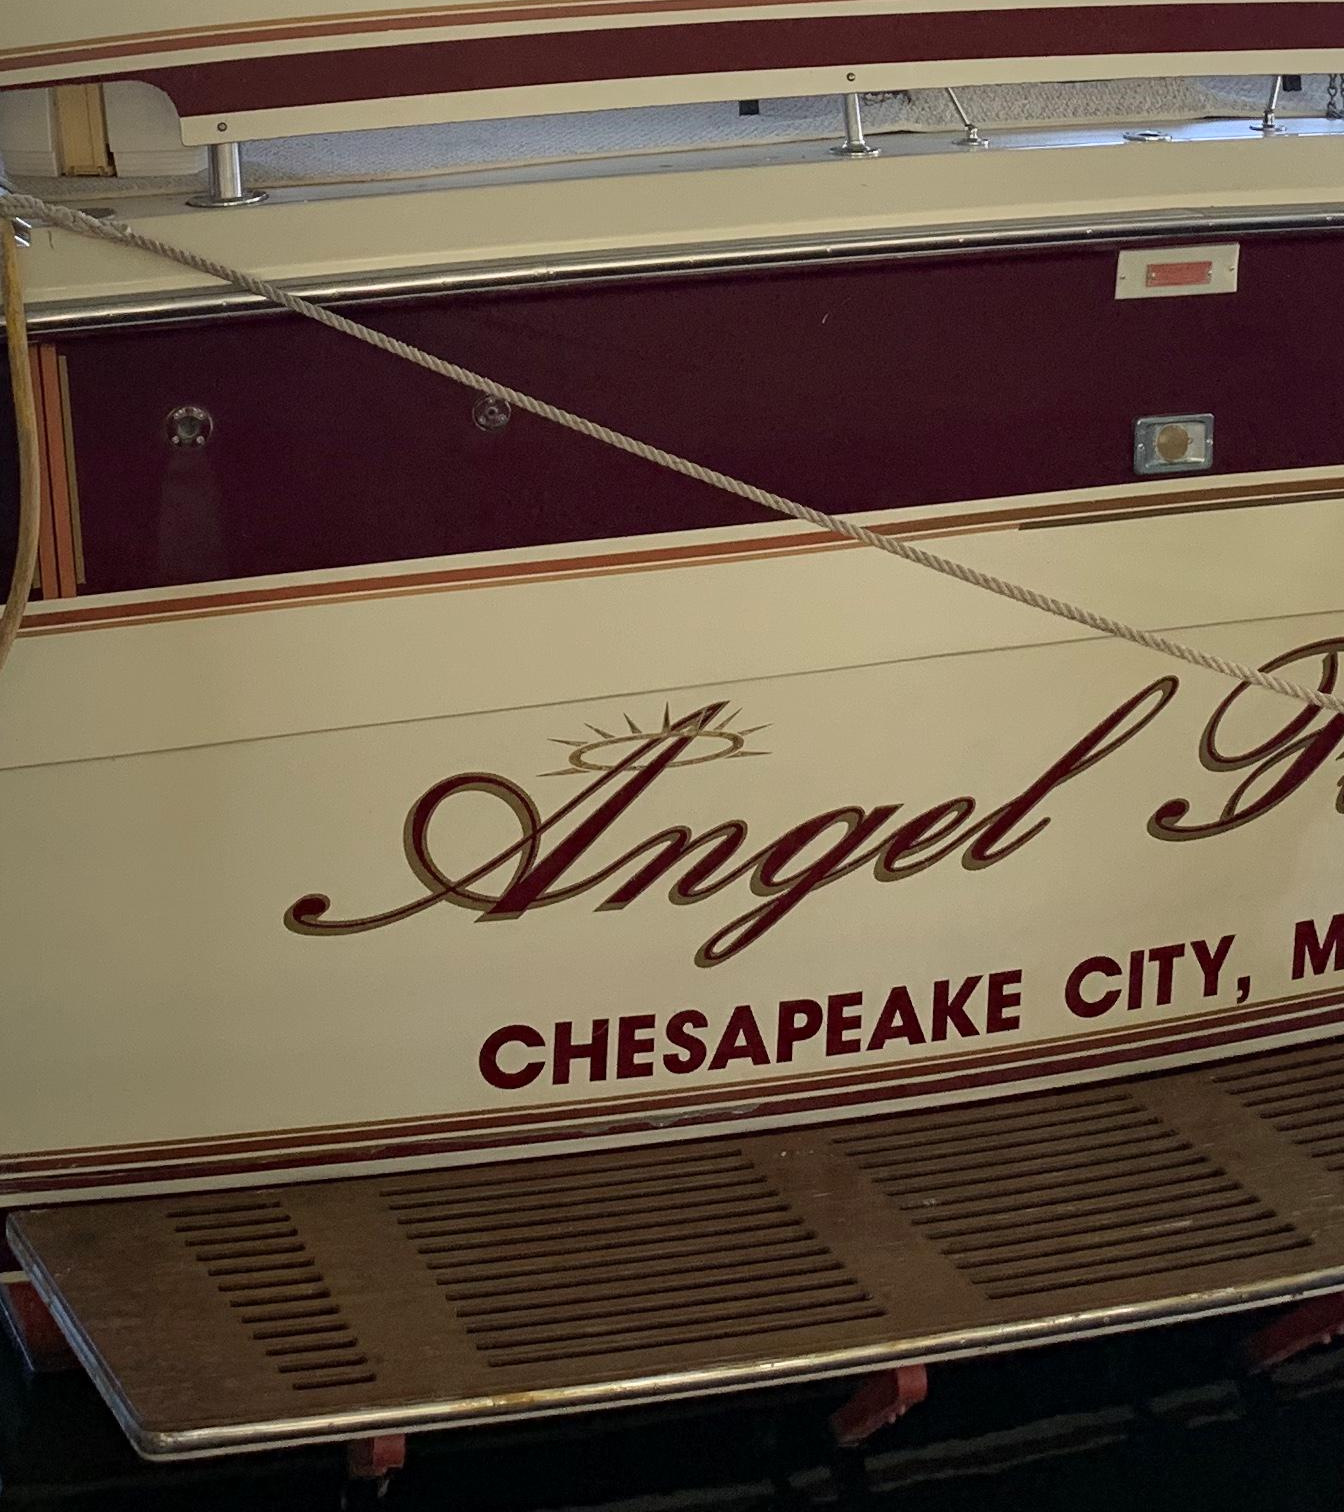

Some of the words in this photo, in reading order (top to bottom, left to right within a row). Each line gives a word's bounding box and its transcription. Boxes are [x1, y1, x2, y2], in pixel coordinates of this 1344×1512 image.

[283, 674, 1180, 968] Angel
[479, 969, 1023, 1090] CHESAPEAKE
[1064, 934, 1252, 1020] CITY,
